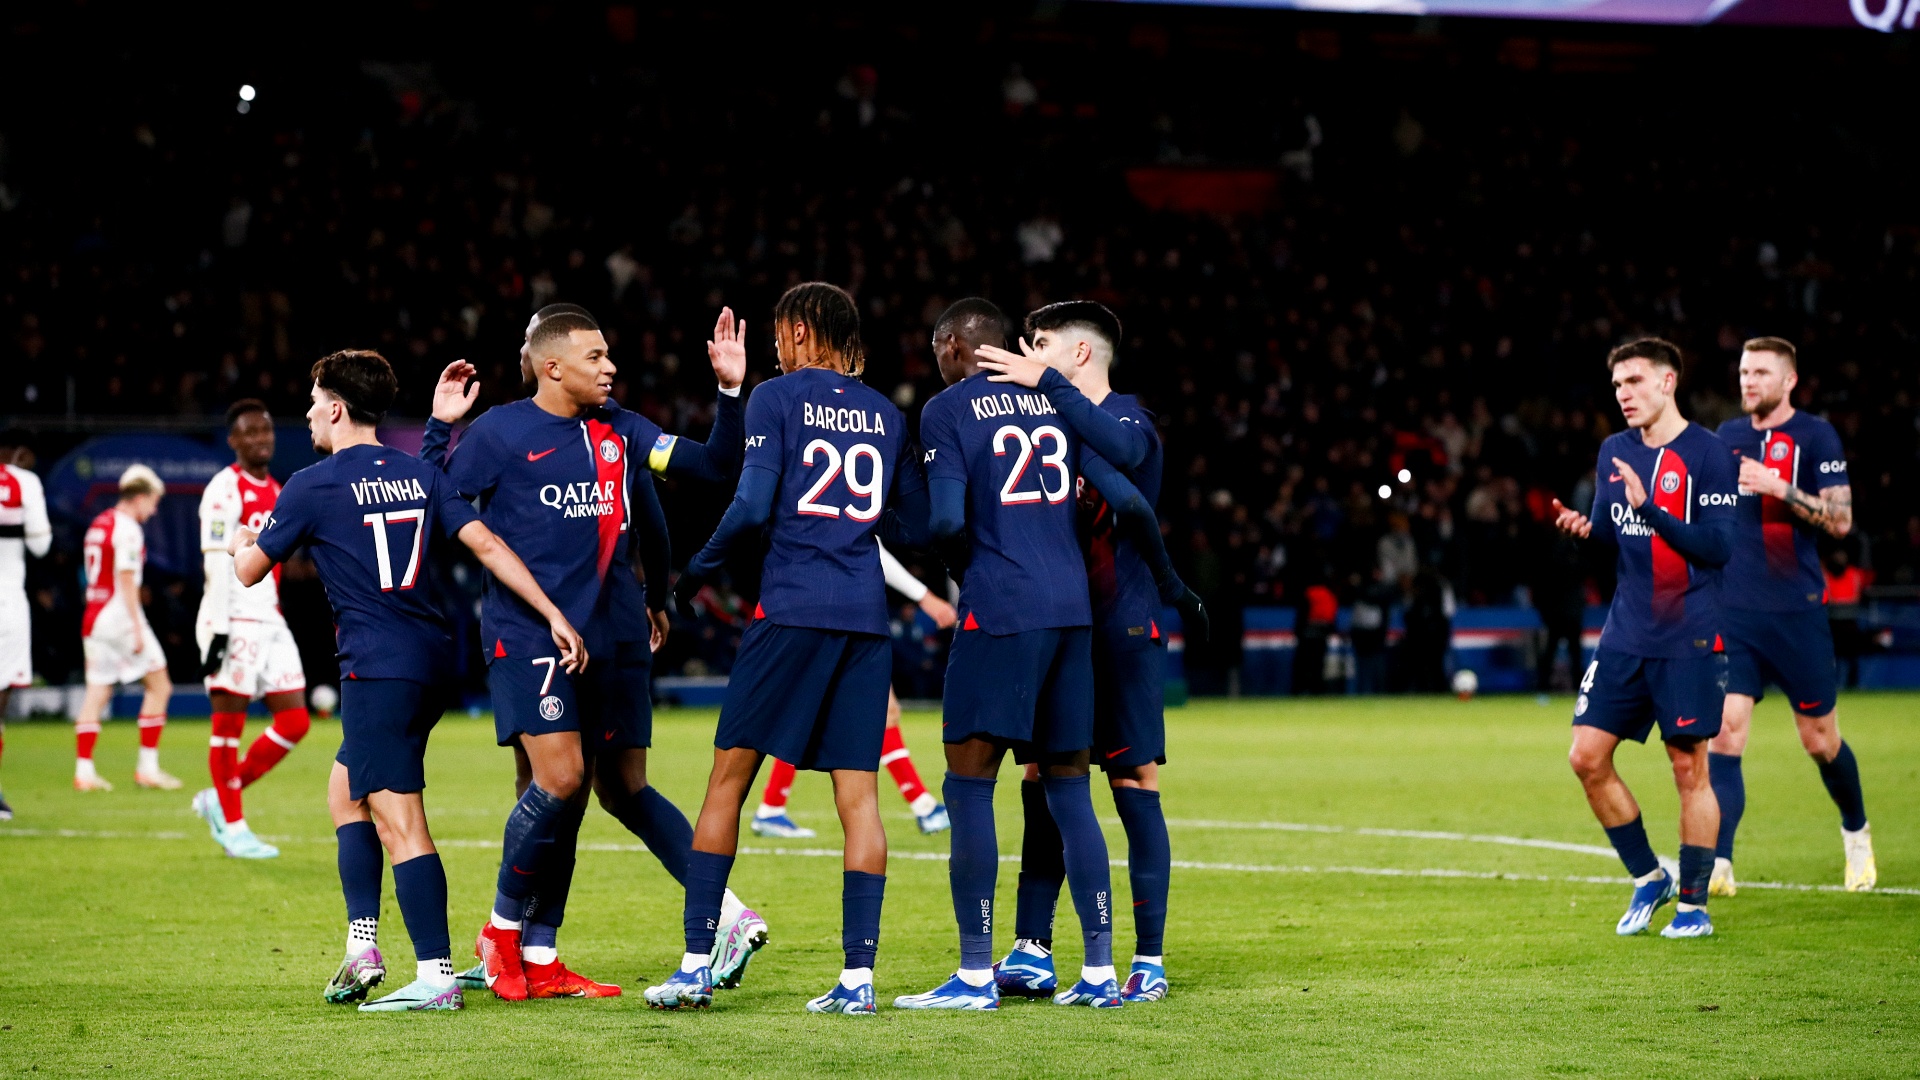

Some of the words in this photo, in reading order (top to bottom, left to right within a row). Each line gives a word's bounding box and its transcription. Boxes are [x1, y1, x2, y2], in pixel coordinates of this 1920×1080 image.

[804, 401, 885, 436] BARCOLA
[971, 393, 1015, 420] KOLO
[1016, 393, 1057, 416] MUA
[745, 435, 767, 451] AT
[923, 448, 937, 464] AT
[797, 438, 884, 523] 29
[992, 425, 1070, 506] 23
[1819, 460, 1847, 474] GOA
[539, 480, 615, 510] QATAR
[1699, 493, 1738, 507] GOAT
[563, 502, 614, 519] AIRWAYS
[1621, 523, 1660, 537] AIRWA
[363, 508, 425, 592] 17
[532, 656, 557, 697] 7
[980, 898, 991, 934] PARIS
[1096, 891, 1109, 925] PARIS
